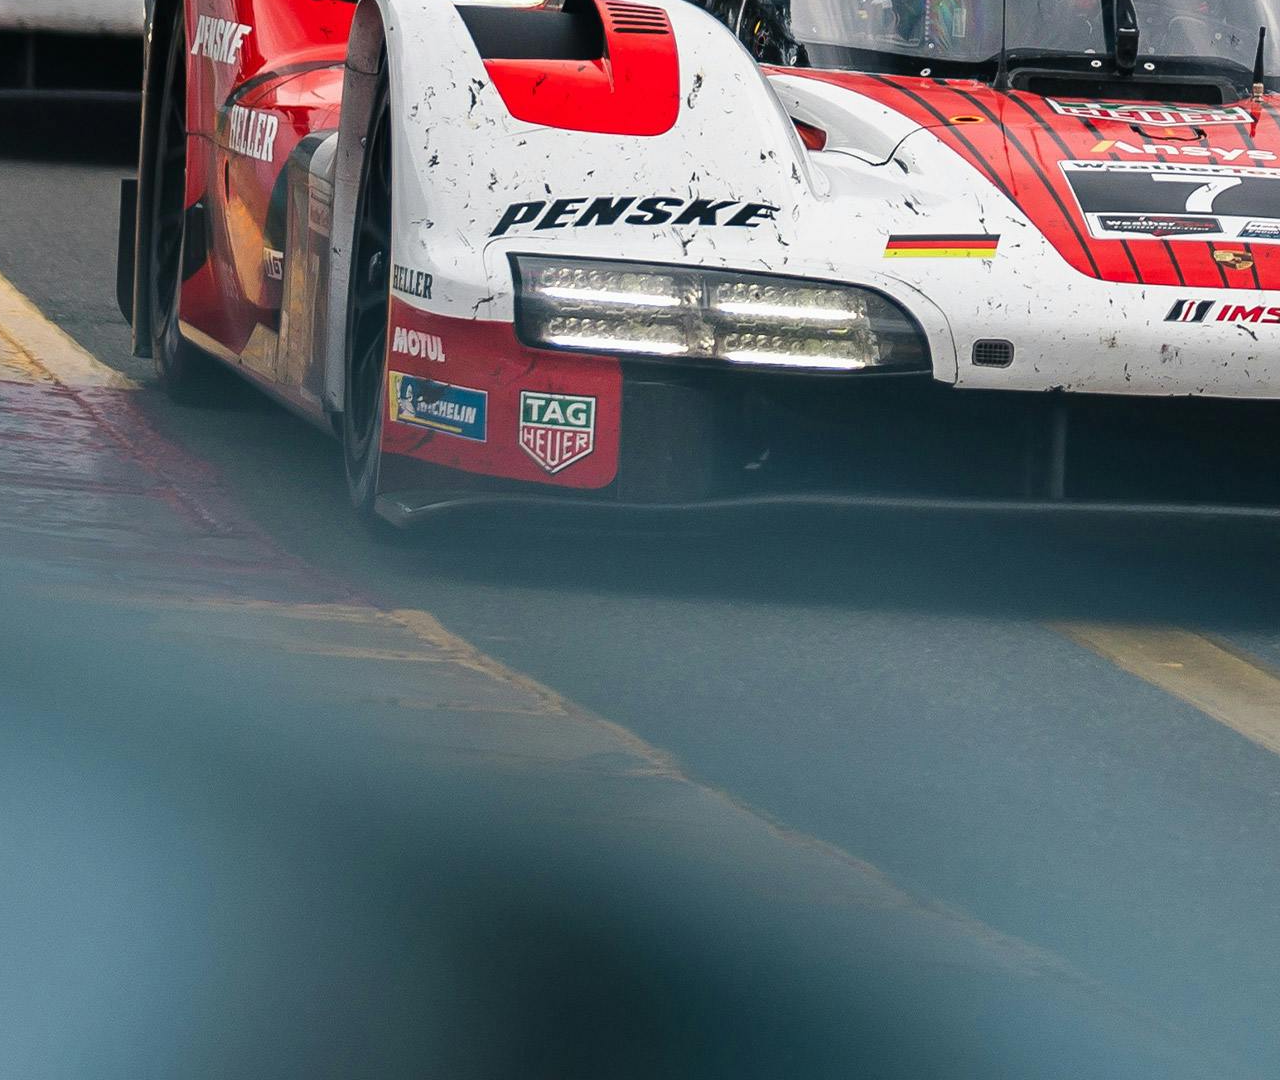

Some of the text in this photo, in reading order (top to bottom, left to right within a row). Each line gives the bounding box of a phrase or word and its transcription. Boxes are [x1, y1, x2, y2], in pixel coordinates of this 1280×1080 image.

[191, 15, 252, 65] PENSKE
[229, 104, 279, 162] HELLER
[1091, 139, 1278, 161] Ansys
[1151, 173, 1243, 213] 7
[488, 196, 781, 237] PENSKE
[393, 264, 433, 299] HELLER
[392, 327, 446, 362] MOTUL
[525, 398, 587, 425] TAG
[523, 428, 588, 466] HEUER
